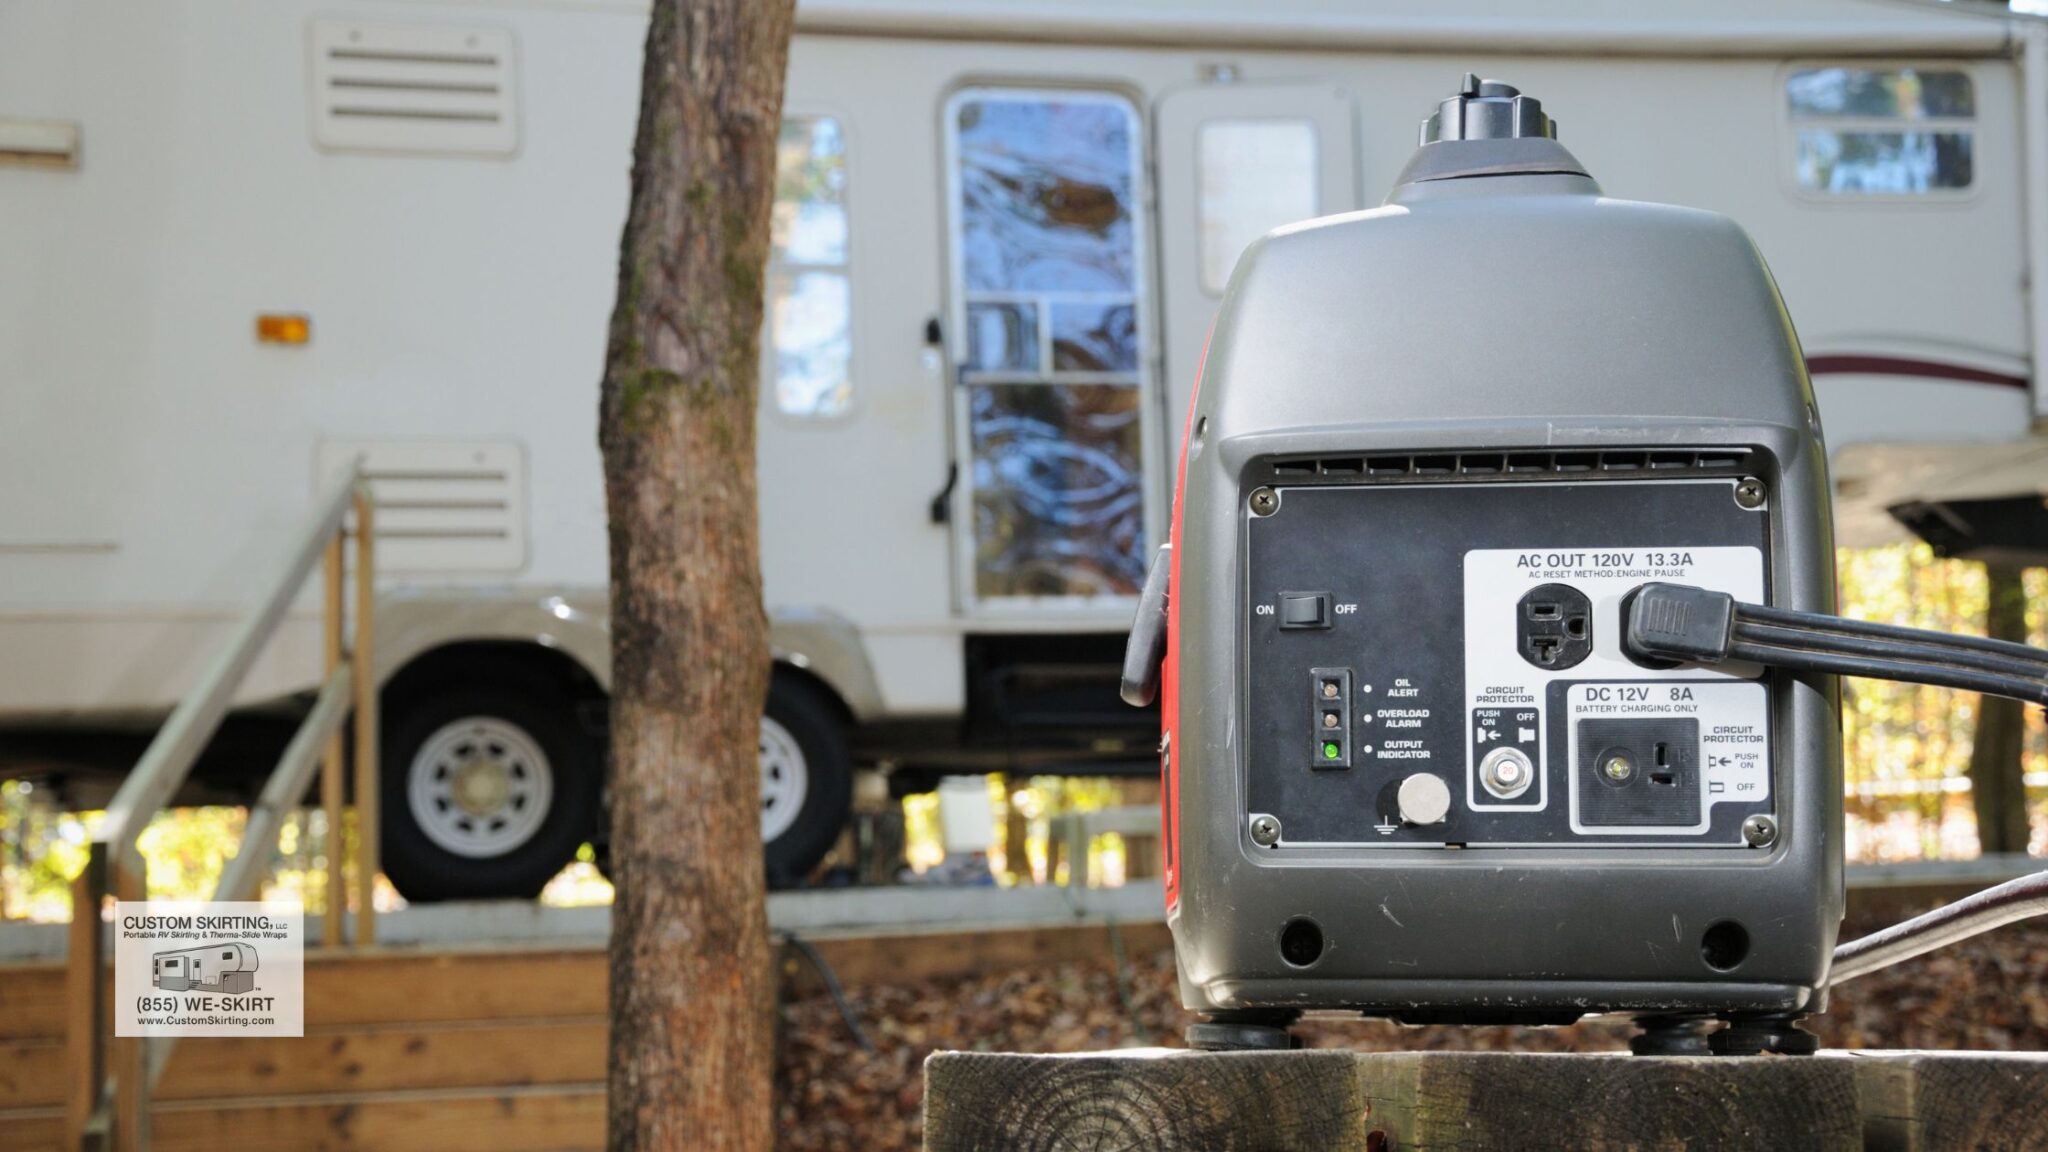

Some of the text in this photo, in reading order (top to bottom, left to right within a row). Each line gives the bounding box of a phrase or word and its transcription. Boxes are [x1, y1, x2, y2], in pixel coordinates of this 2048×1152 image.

[1517, 553, 1693, 567] AC OUT 120V 13.3A
[1543, 570, 1571, 578] RESET
[1655, 569, 1685, 577] PAUSE
[1256, 605, 1274, 615] ON
[1335, 604, 1357, 614] OFF
[1395, 679, 1410, 687] OIL
[1388, 689, 1418, 697] ALERT
[1486, 686, 1525, 694] CIRCUIT
[1586, 688, 1693, 701] DC 12V 8A
[1476, 695, 1534, 703] PROTECTOR
[1576, 704, 1698, 713] BATTERY CHARGING ONLY
[1377, 710, 1429, 718] OVERLOAD
[1477, 710, 1500, 718] PUSH
[1517, 713, 1535, 721] OFF
[1386, 720, 1421, 728] ALARM
[1482, 718, 1495, 726] ON
[1713, 726, 1753, 734] CIRCUIT
[1703, 735, 1764, 743] PROTECTOR
[1384, 741, 1423, 749] OUTPUT
[1377, 751, 1430, 759] INDICATOR
[1740, 761, 1754, 769] ON
[1737, 783, 1755, 791] OFF
